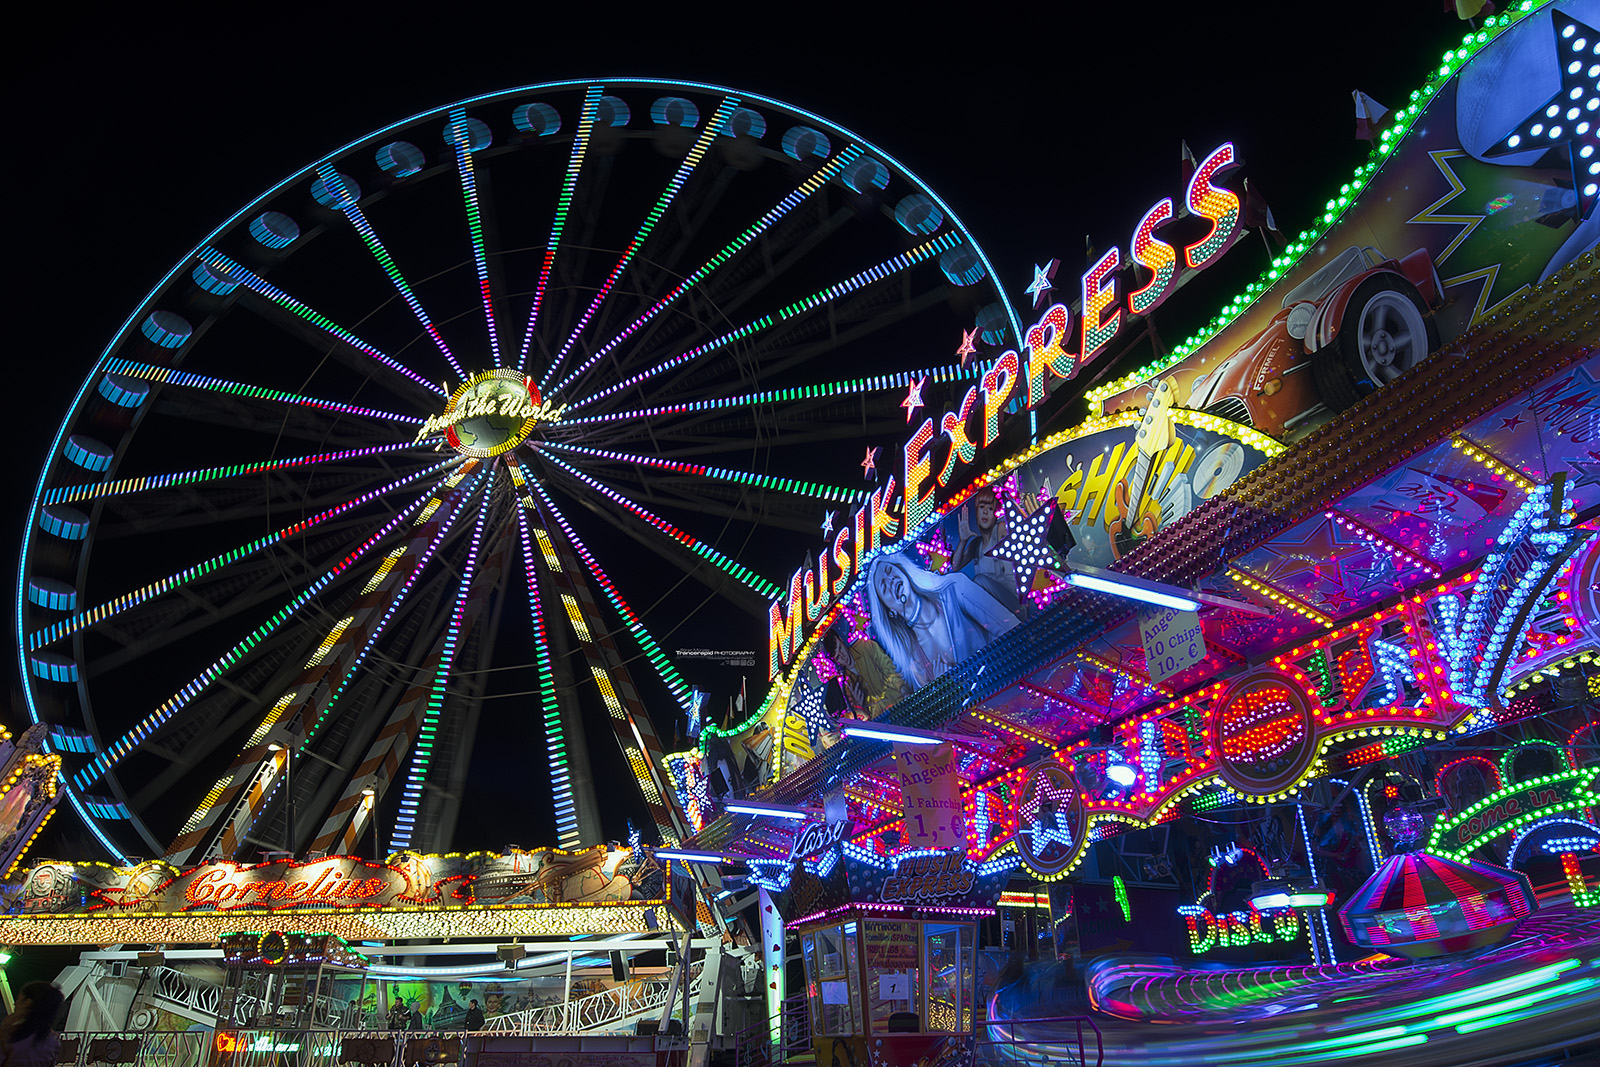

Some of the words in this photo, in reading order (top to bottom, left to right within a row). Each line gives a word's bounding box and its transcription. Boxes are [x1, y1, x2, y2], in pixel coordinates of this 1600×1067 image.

[1253, 342, 1281, 390] FORMEL
[467, 390, 496, 417] the
[499, 392, 567, 423] World
[1506, 533, 1540, 588] FUN
[1144, 608, 1181, 644] Angeb
[1147, 640, 1165, 661] 10
[1168, 624, 1200, 649] Chips
[1158, 655, 1185, 677] 10,-
[1188, 642, 1199, 659] €
[783, 710, 817, 761] DIS
[901, 751, 930, 766] Top
[901, 761, 957, 788] Angebot
[906, 796, 915, 809] 1
[1458, 798, 1523, 844] come
[1528, 789, 1563, 808] in
[788, 819, 846, 862] Kasse
[914, 814, 946, 842] 1,-
[951, 815, 964, 839] €
[765, 866, 784, 877] JUS
[896, 853, 966, 877] MUSIK
[186, 866, 389, 903] Cornelius
[883, 872, 973, 898] EXPRESS
